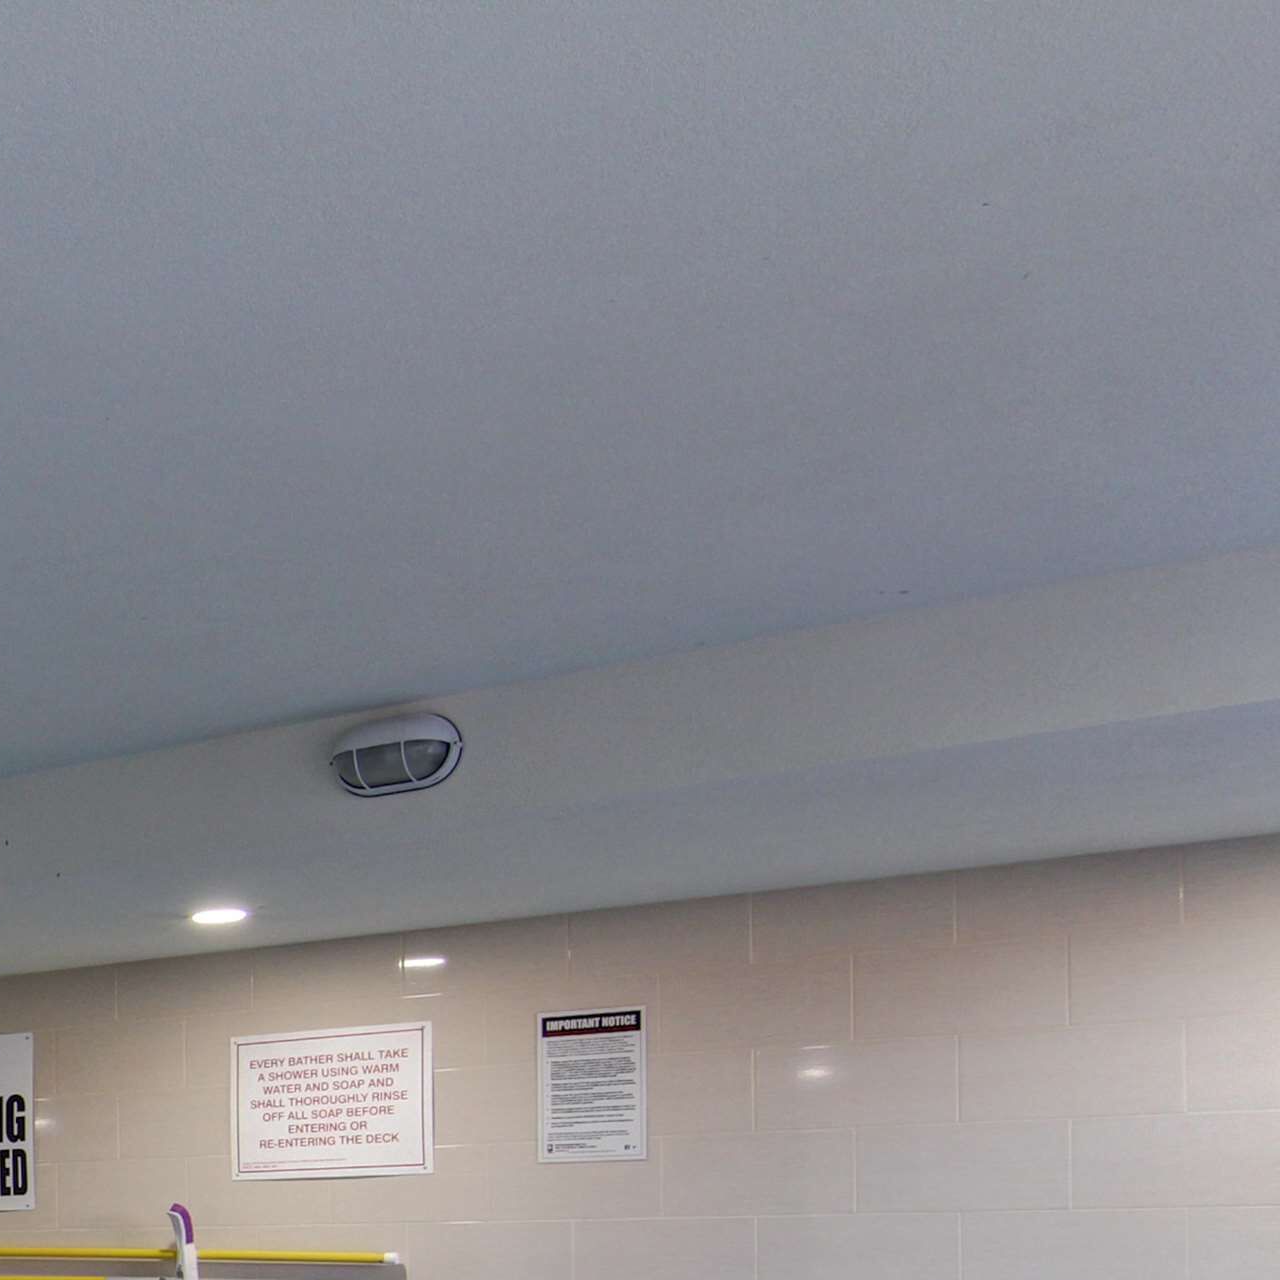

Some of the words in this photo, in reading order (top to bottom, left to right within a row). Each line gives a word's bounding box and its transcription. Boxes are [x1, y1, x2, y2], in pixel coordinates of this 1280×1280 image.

[546, 1017, 600, 1032] IMPORTANT
[601, 1014, 637, 1027] NOTICE
[249, 1058, 285, 1069] EVERY
[288, 1054, 333, 1067] BATHER
[337, 1051, 375, 1062] SHALL
[377, 1048, 409, 1060] TAKE
[257, 1073, 266, 1082] A
[268, 1069, 318, 1082] SHOWER
[321, 1066, 358, 1078] USING
[361, 1063, 400, 1075] WARM
[262, 1083, 303, 1095] WATER
[304, 1081, 329, 1093] AND
[332, 1079, 365, 1090] SOAP
[367, 1077, 394, 1088] AND
[250, 1098, 285, 1109] SHALL
[288, 1093, 370, 1107] THOROUGHLY
[372, 1090, 408, 1101] RINSE
[262, 1111, 285, 1122] OFF
[287, 1110, 308, 1120] ALL
[311, 1107, 343, 1119] SOAP
[346, 1104, 395, 1117] BEFORE
[288, 1122, 347, 1135] ENTERING
[350, 1120, 368, 1131] OR
[259, 1135, 336, 1149] RE-ENTERING
[339, 1134, 363, 1145] THE
[366, 1133, 400, 1144] DECK
